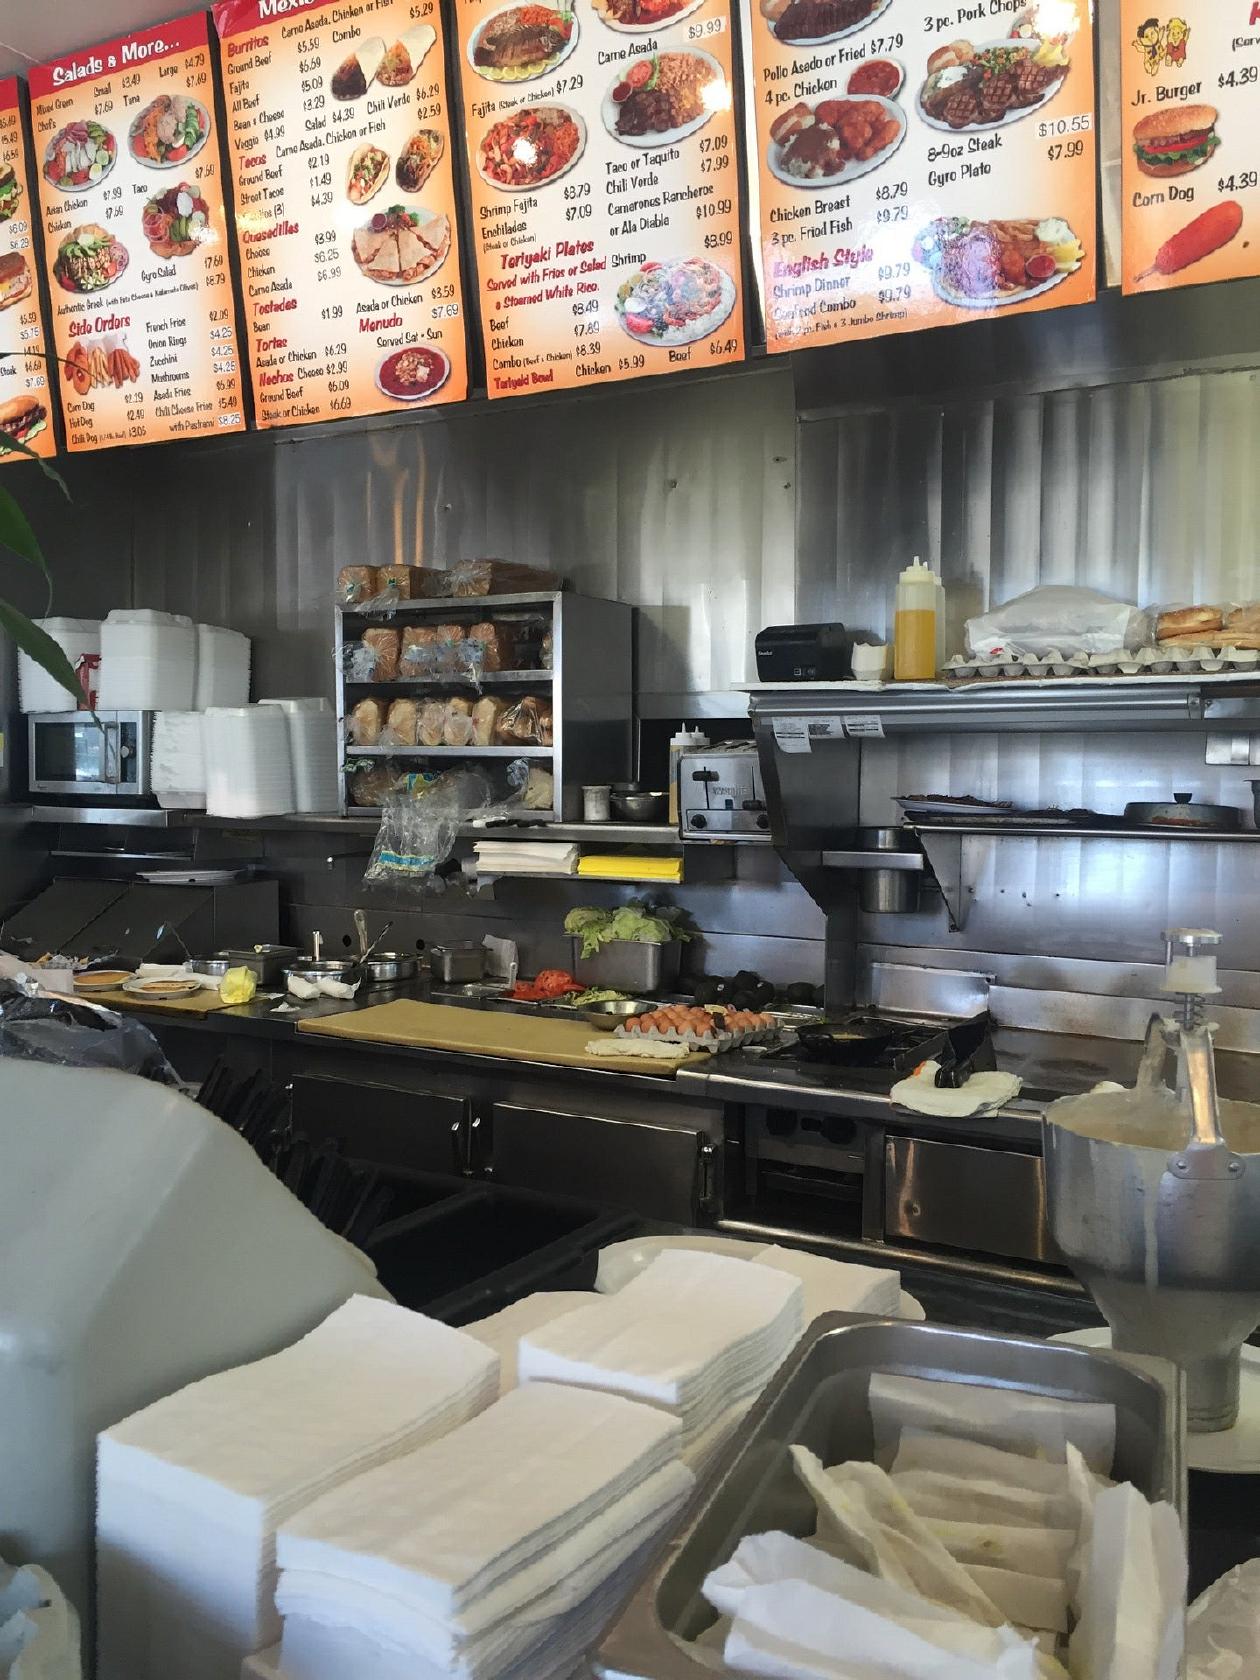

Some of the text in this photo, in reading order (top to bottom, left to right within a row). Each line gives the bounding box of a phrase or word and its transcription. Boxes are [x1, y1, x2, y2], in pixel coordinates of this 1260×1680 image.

[227, 36, 269, 57] Burritos
[282, 20, 304, 39] Carne
[333, 6, 363, 23] Chicken
[366, 4, 375, 12] or
[689, 18, 721, 39] $9.99
[924, 0, 1026, 32] 3 pc. Pork Chops
[227, 2, 433, 75] Ground Beef $5.59 Combo $5.29
[598, 40, 658, 65] Carne Asada
[53, 40, 180, 86] Salads & More...
[763, 34, 903, 81] Pollo Asado or Fried $7.79
[472, 100, 496, 118] Fajita
[499, 96, 518, 111] (Steak
[528, 86, 554, 102] Chicken)
[557, 75, 584, 94] $7.29
[776, 91, 790, 107] pc.
[794, 79, 837, 98] Chicken
[1132, 67, 1258, 106] Jr. Burger $4.39
[38, 95, 140, 132] Chef's Tuna
[235, 84, 440, 151] Veggie $4.99 Salad $4.39 Chili Verde $6.29
[239, 154, 267, 171] Tacos
[276, 141, 298, 157] Carne
[326, 128, 356, 144] Chicken
[359, 128, 367, 136] or
[369, 120, 386, 134] Fish
[417, 104, 441, 120] $2.59
[968, 133, 1003, 153] Steak
[1039, 115, 1089, 137] $10.55
[239, 154, 329, 187] Ground Beef $2.19
[606, 135, 728, 175] Taco or Taquito $7.09
[928, 141, 1083, 187] Gyro Plate $7.99
[241, 173, 332, 206] Street Tacos $1.49
[606, 155, 729, 194] Chili Verde $7.99
[1132, 172, 1258, 207] Corn Dog $4.39
[46, 184, 148, 216] Asian Chicken Taco
[480, 183, 591, 220] Shrimp Fajita $8.79
[607, 183, 714, 216] Camarones Rancheros
[770, 182, 908, 222] Chicken Breast $8.79
[48, 220, 71, 233] Chicken
[243, 221, 299, 244] Quesadillas
[482, 204, 592, 239] Enchiladas $7.09
[610, 199, 731, 237] or Ala Diabla $10.99
[782, 231, 796, 247] pc.
[800, 222, 827, 241] Fried
[830, 219, 853, 234] Fish
[877, 205, 909, 222] $9.79
[247, 249, 339, 278] Chicken $6.25
[501, 239, 594, 270] Teriyaki Plates
[612, 251, 646, 268] Shrimp
[773, 244, 873, 278] English Style
[142, 265, 176, 283] Gyro Salad
[249, 267, 341, 297] Carne Asada $6.99
[487, 256, 606, 292] Served with Fries or Salad
[773, 262, 910, 298] Shrimp Dinner $9.79
[253, 299, 297, 316] Tostadas
[253, 284, 455, 333] Bean $1.99 Asada or Chicken $3.59
[359, 304, 458, 333] Menudo $7.69
[69, 313, 130, 337] Side Orders
[146, 318, 186, 333] French Fries
[149, 327, 232, 349] Onion Rings $4.25
[377, 329, 442, 348] Served Sat Sun
[150, 346, 233, 367] Zucchini $4.25
[256, 337, 287, 352] Tortas
[492, 337, 524, 351] Chicken
[151, 361, 235, 383] Mushrooms $4.25
[494, 339, 737, 390] Teriyaki Bowl Chicken $5.99 Beef $6.49
[68, 401, 94, 413] Corn Dog
[260, 387, 303, 404] Ground Beef
[69, 417, 92, 428] Hot Dog
